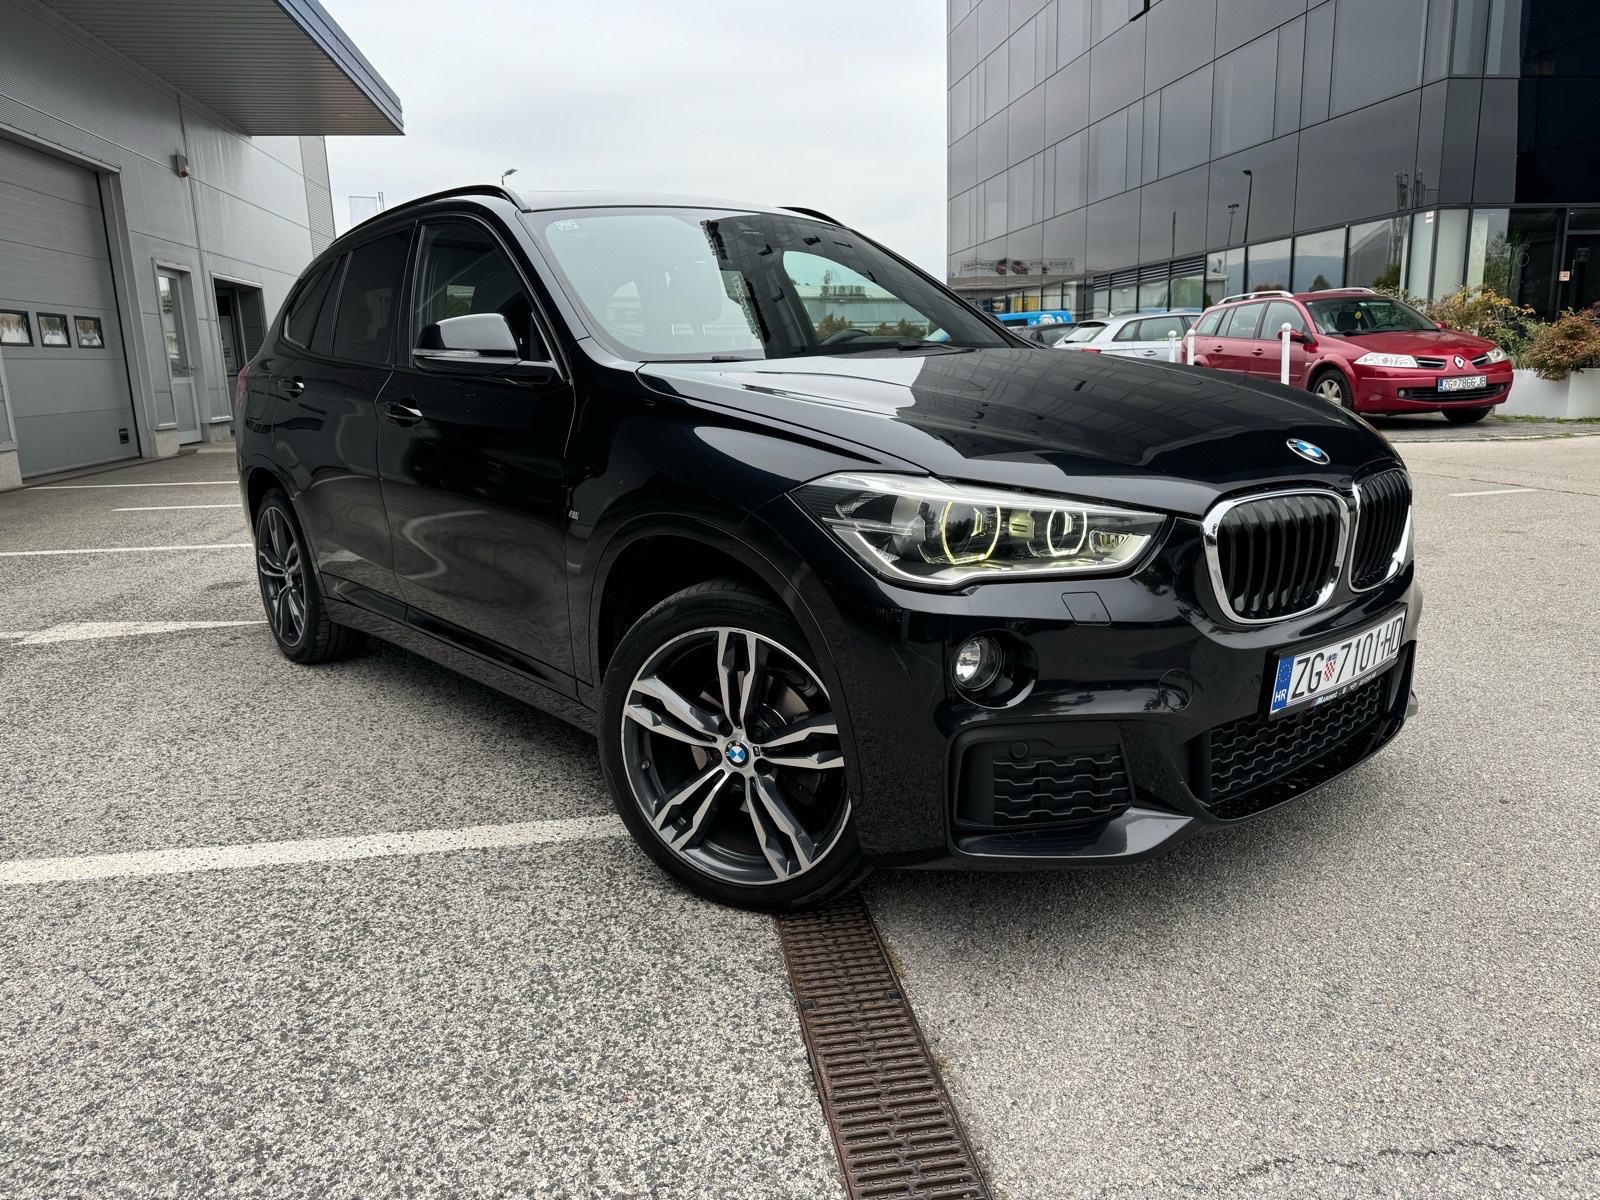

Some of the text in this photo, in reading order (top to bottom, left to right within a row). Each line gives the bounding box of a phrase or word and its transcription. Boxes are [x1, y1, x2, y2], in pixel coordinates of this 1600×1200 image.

[1291, 616, 1404, 700] ZG 7101-HD
[1274, 688, 1288, 704] HR
